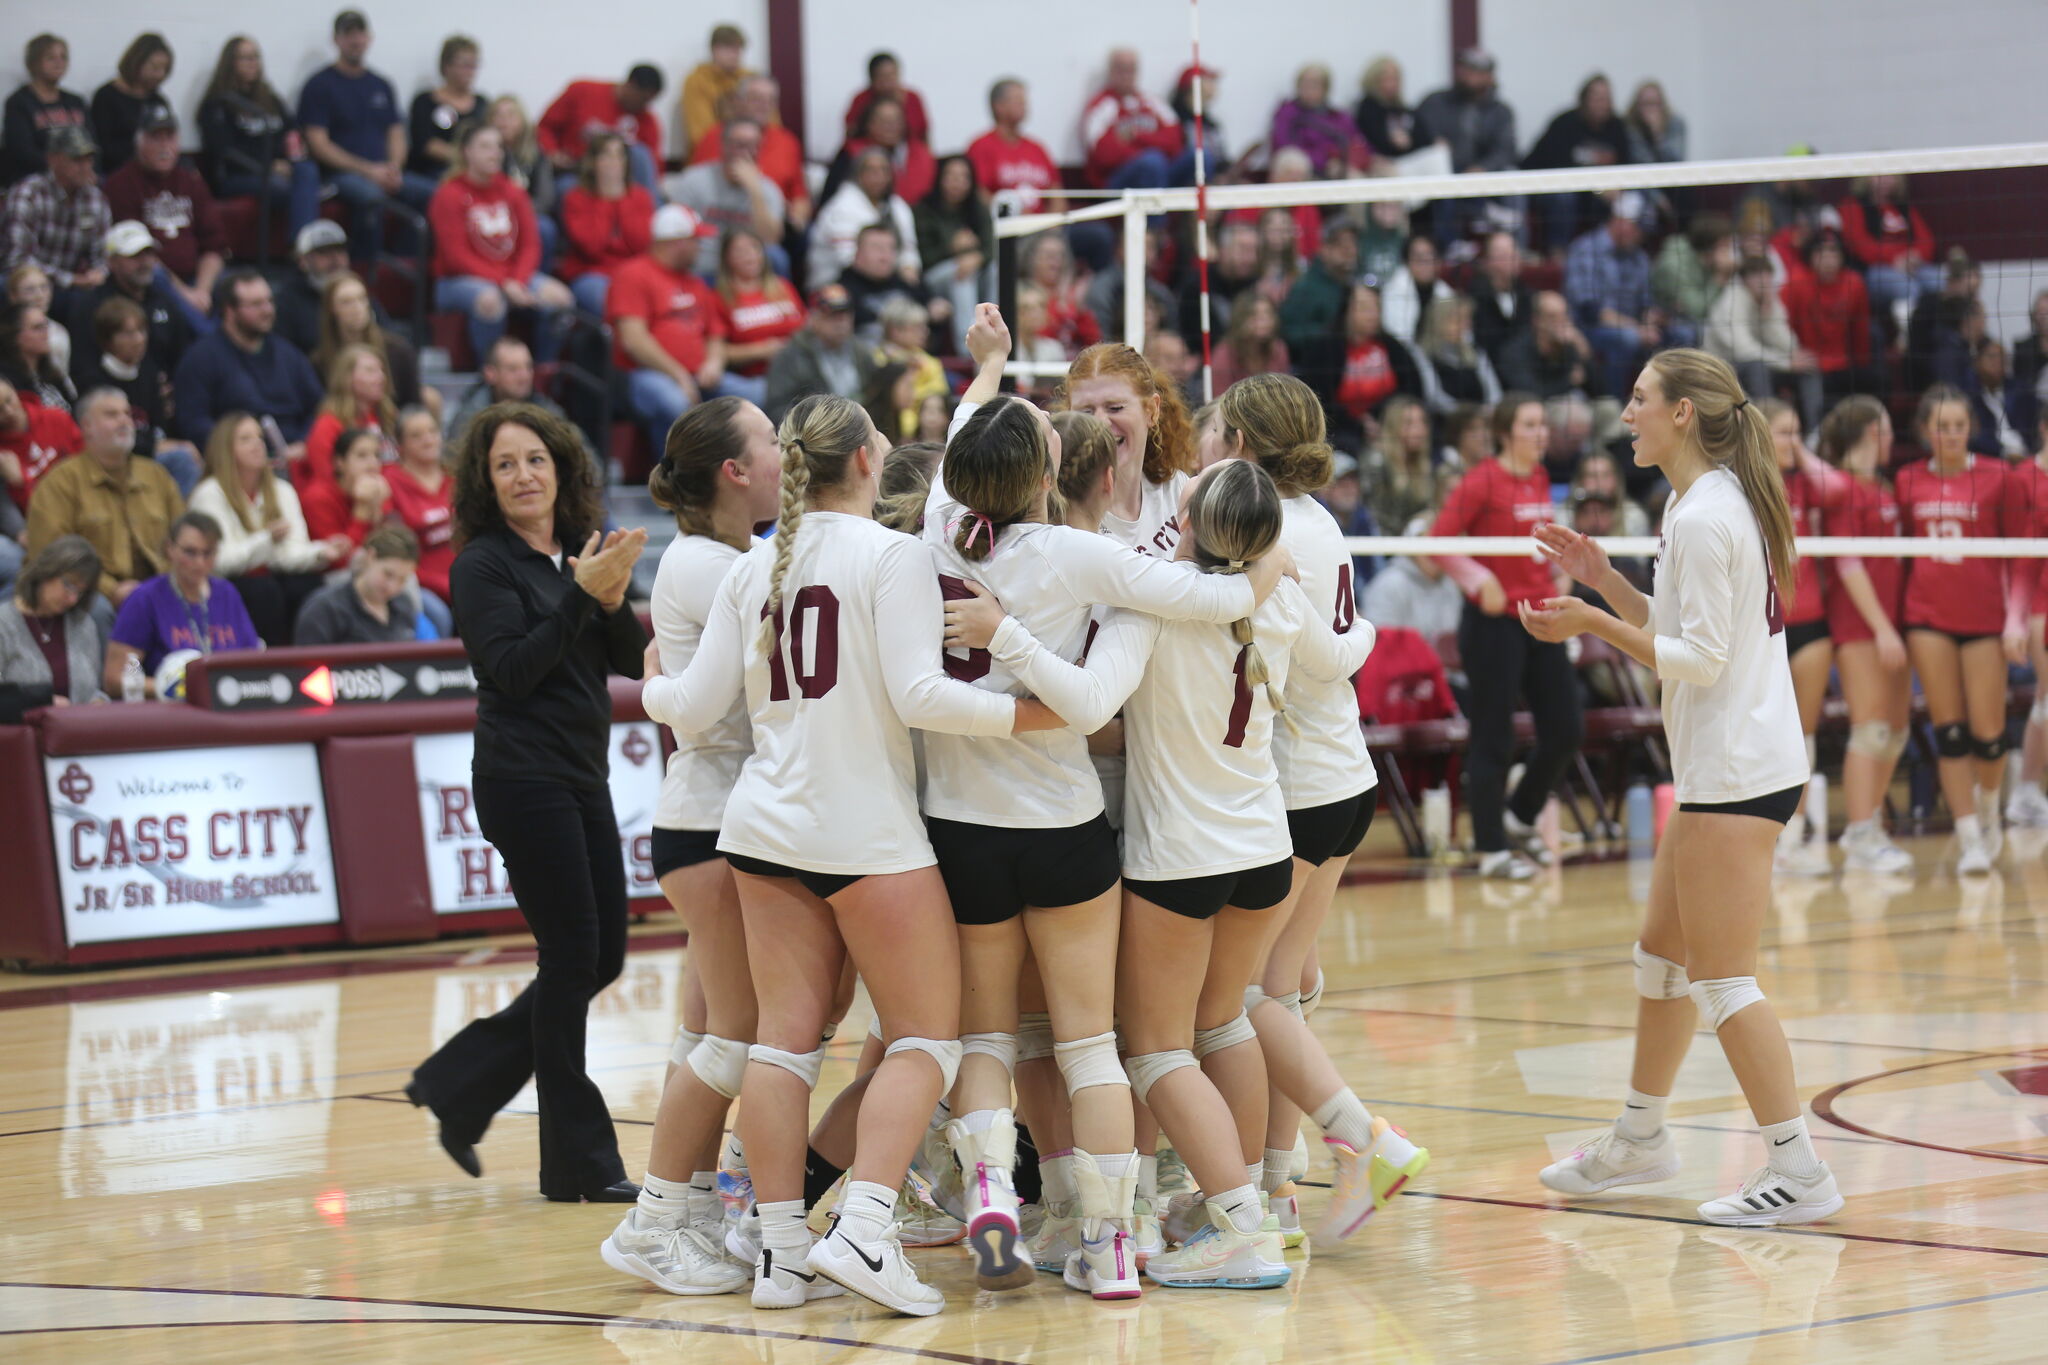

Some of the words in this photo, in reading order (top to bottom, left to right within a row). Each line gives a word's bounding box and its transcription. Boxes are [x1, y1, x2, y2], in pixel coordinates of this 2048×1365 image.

[171, 625, 236, 648] MTH
[759, 584, 840, 701] 10
[332, 669, 383, 700] POSS
[117, 778, 213, 798] Welcome
[220, 771, 246, 792] To
[70, 813, 191, 871] CASS
[208, 805, 313, 861] CITY
